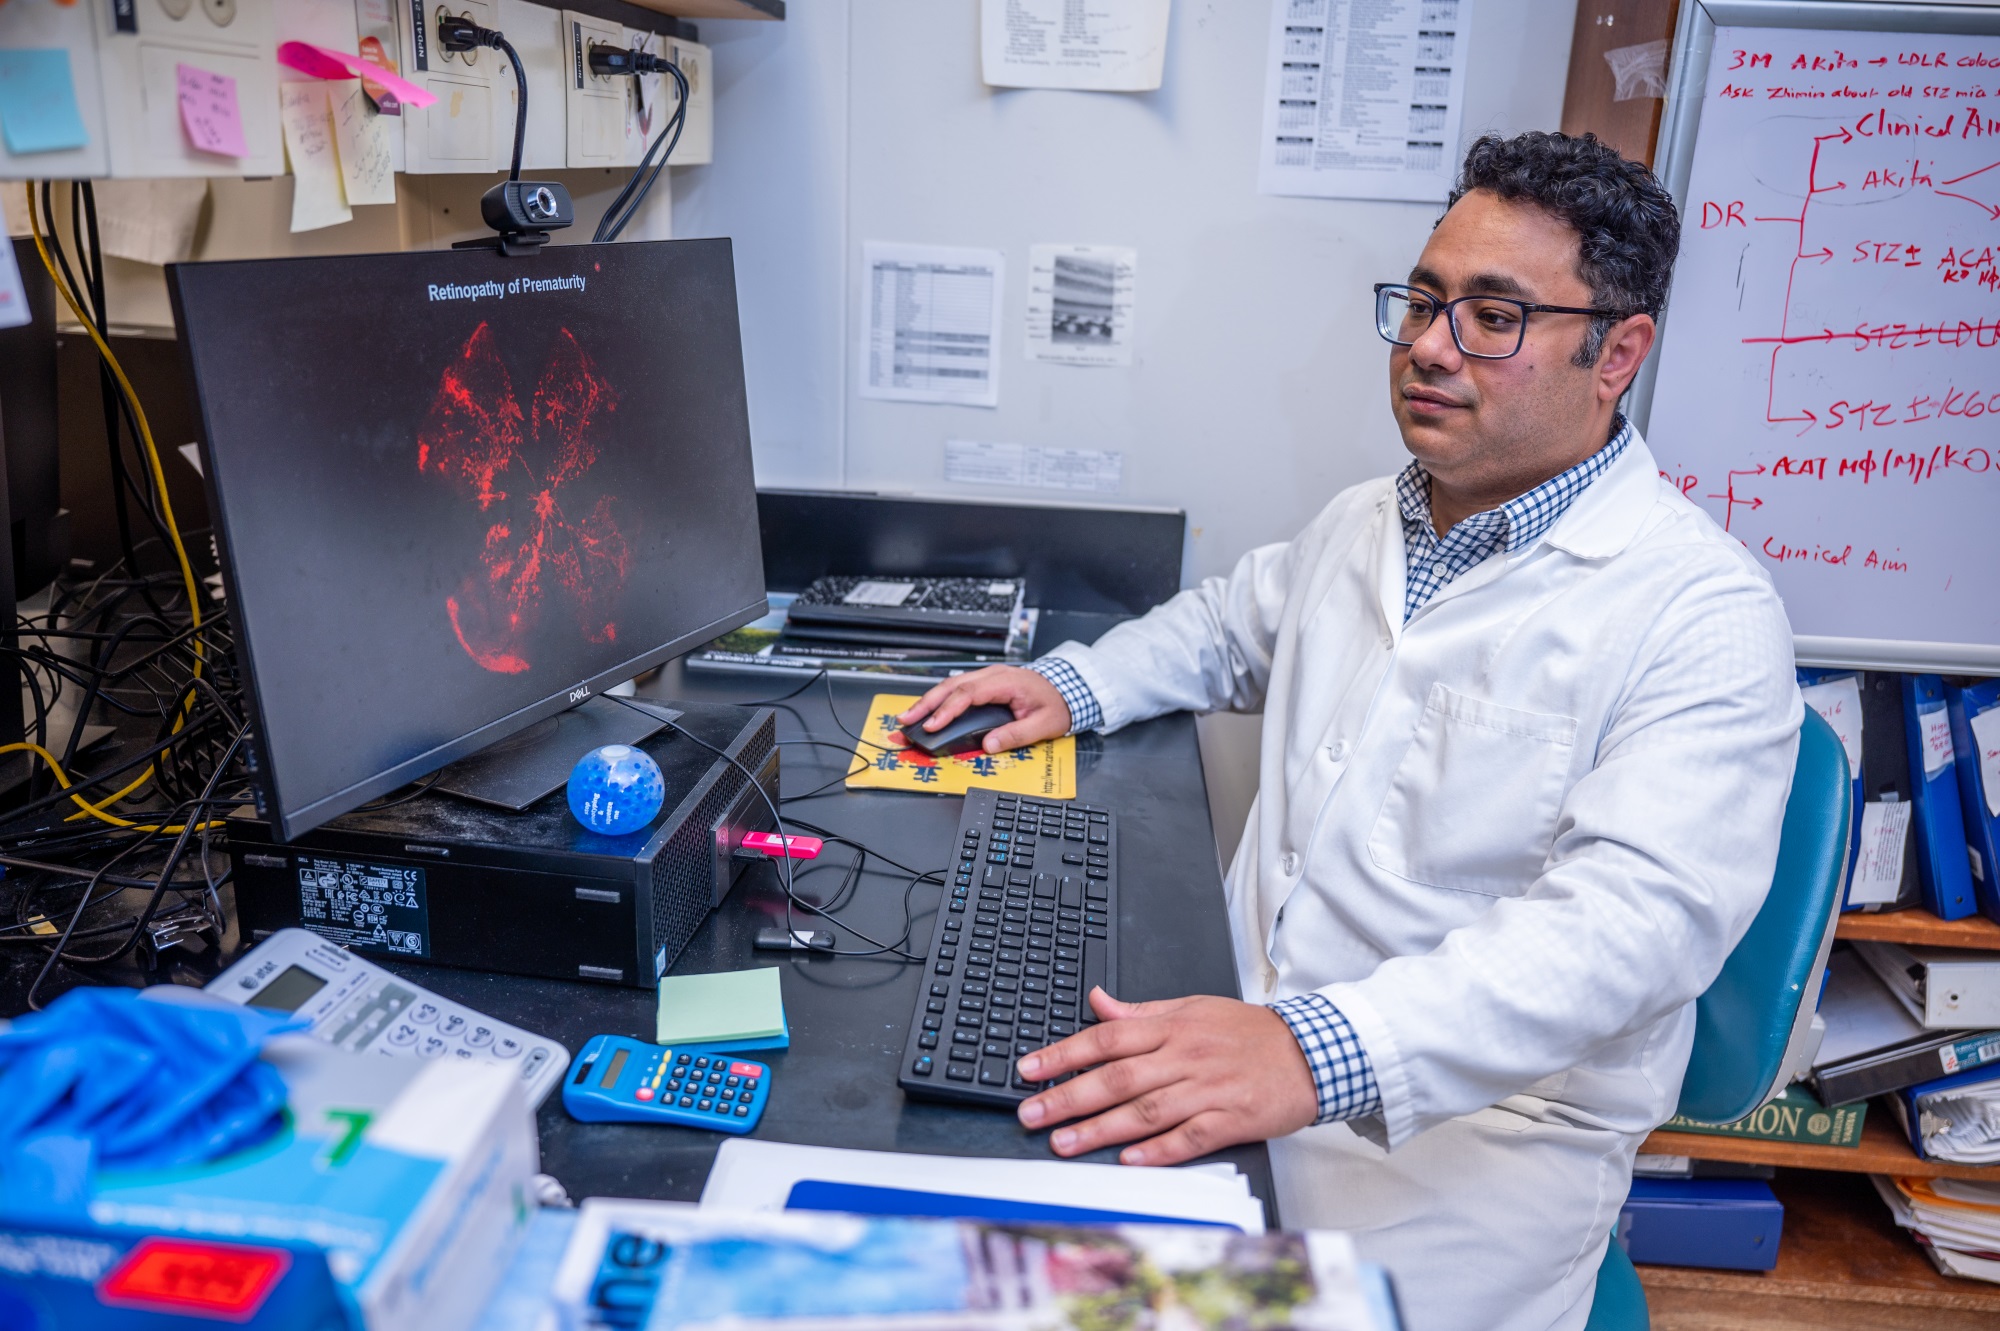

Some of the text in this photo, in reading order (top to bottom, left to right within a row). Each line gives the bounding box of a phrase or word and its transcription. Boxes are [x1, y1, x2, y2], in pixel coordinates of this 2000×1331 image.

[1727, 50, 1772, 70] 3M
[1898, 52, 1948, 68] LDLR
[1720, 84, 1753, 99] Ask
[1832, 87, 1879, 99] about
[1888, 84, 1912, 98] old
[1923, 86, 1950, 98] STZ
[1856, 108, 1954, 137] Clinical
[1700, 201, 1747, 229] DR
[1937, 246, 2000, 270] ACA
[427, 274, 586, 302] Retinopathy of Prematurity
[1825, 399, 1897, 431] STZ
[1772, 455, 1827, 480] ACAT
[1763, 536, 1908, 572] Clinical Aim
[569, 685, 591, 703] DELL
[423, 1003, 437, 1013] 3
[400, 1024, 416, 1035] 2
[449, 1014, 464, 1025] 6
[476, 1026, 490, 1036] 9
[428, 1036, 443, 1047] 5
